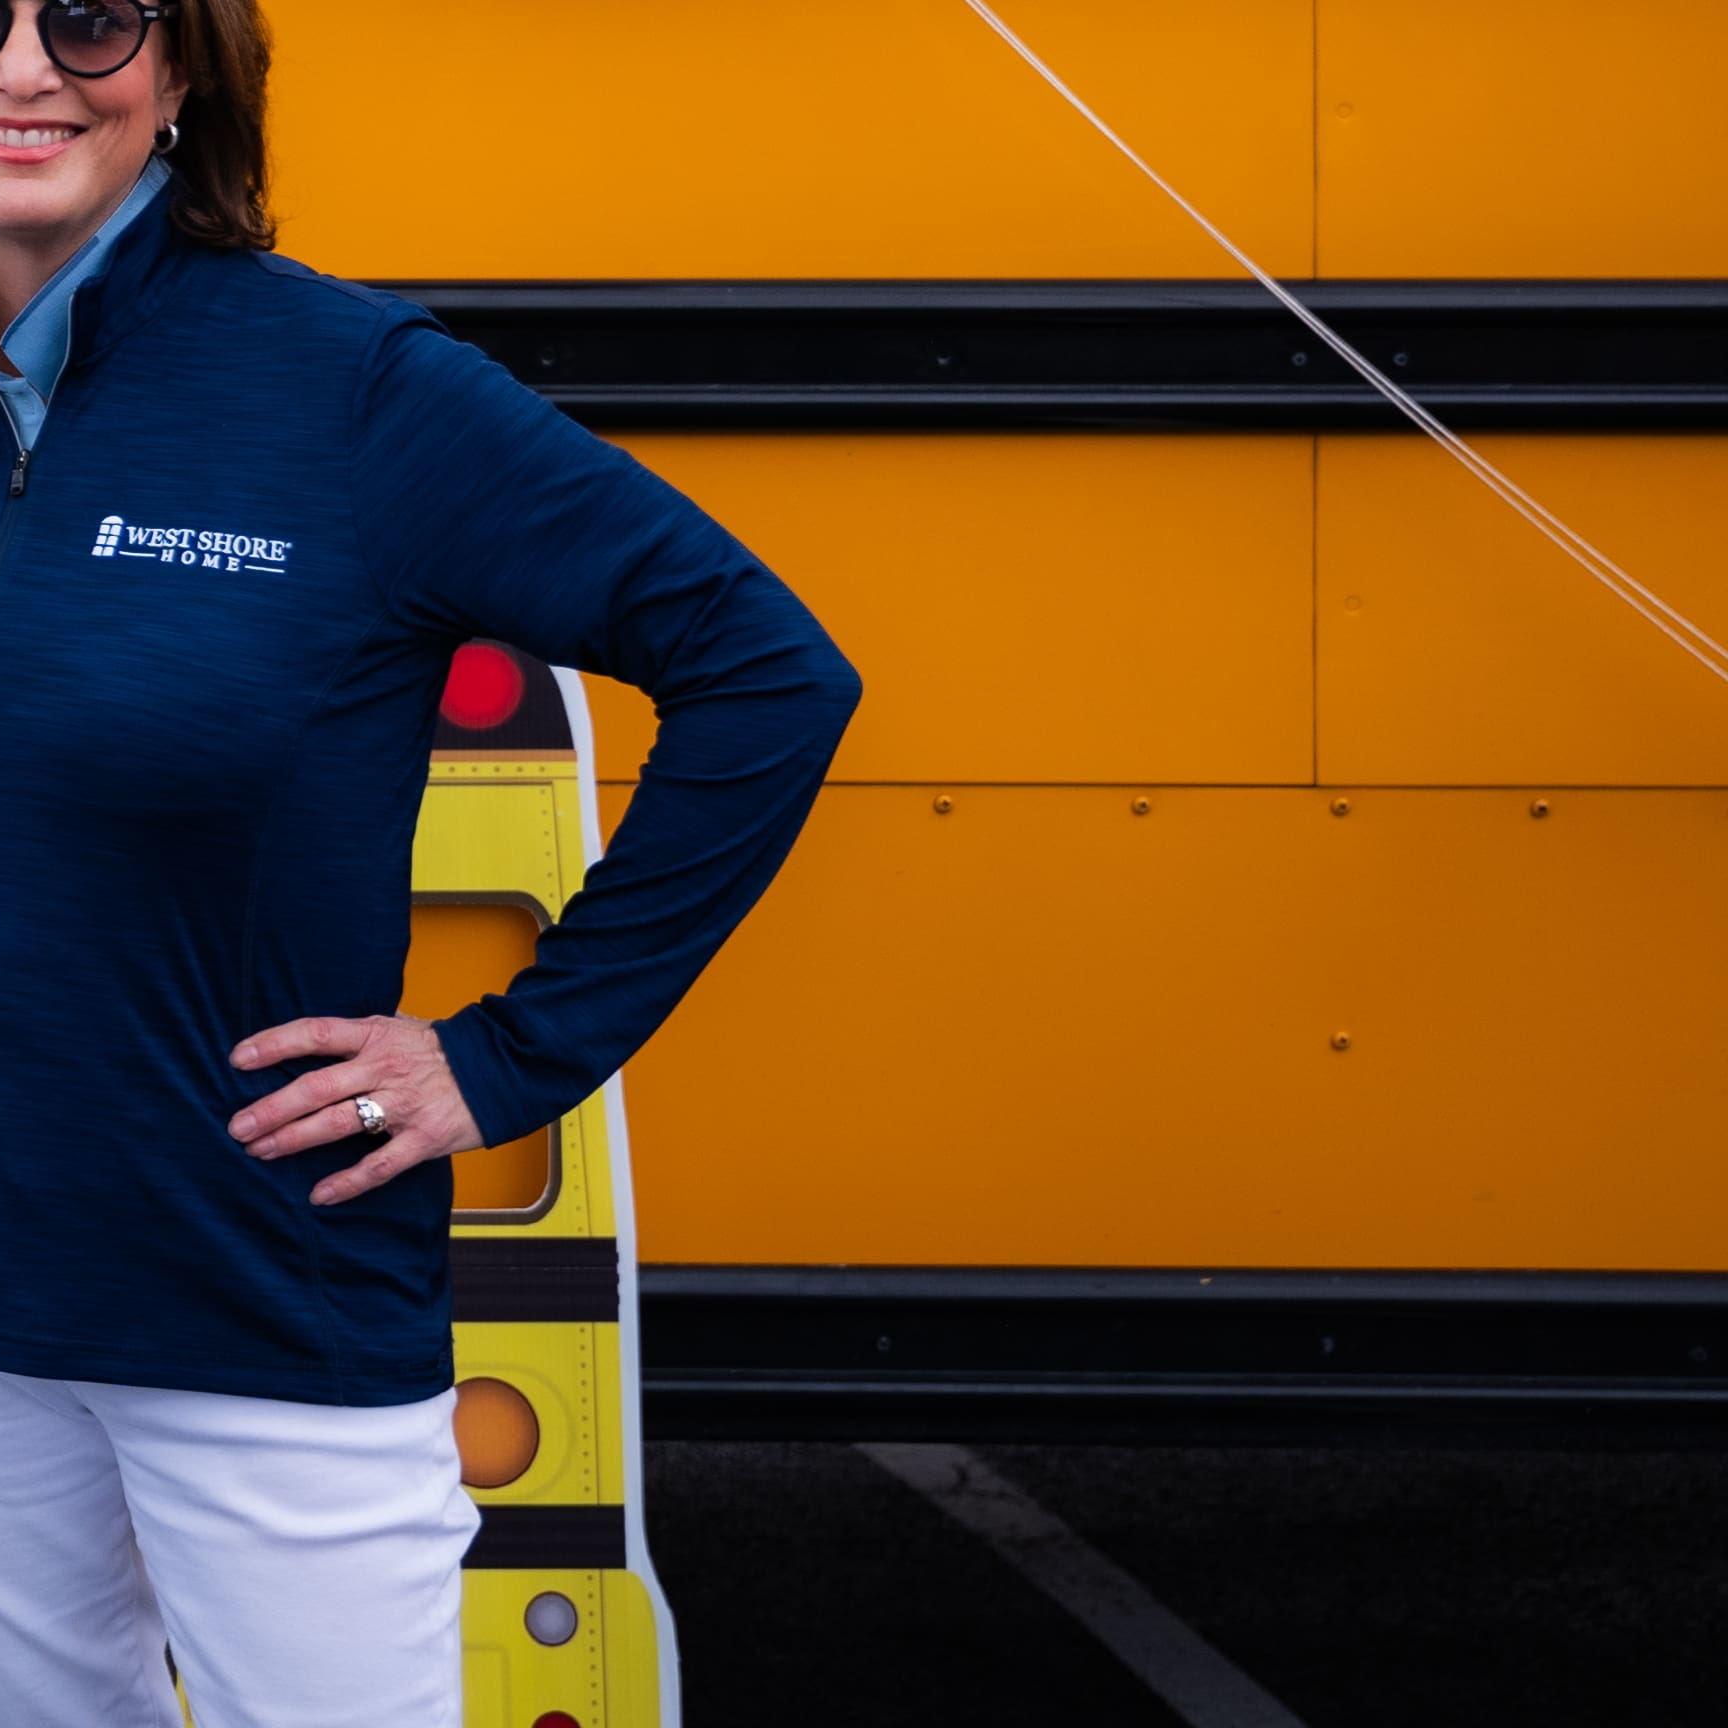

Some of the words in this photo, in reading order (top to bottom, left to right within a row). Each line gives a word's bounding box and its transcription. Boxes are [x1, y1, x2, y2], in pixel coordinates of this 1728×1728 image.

[126, 525, 194, 548] WEST
[197, 530, 286, 562] SHORE
[160, 549, 240, 571] HOME
